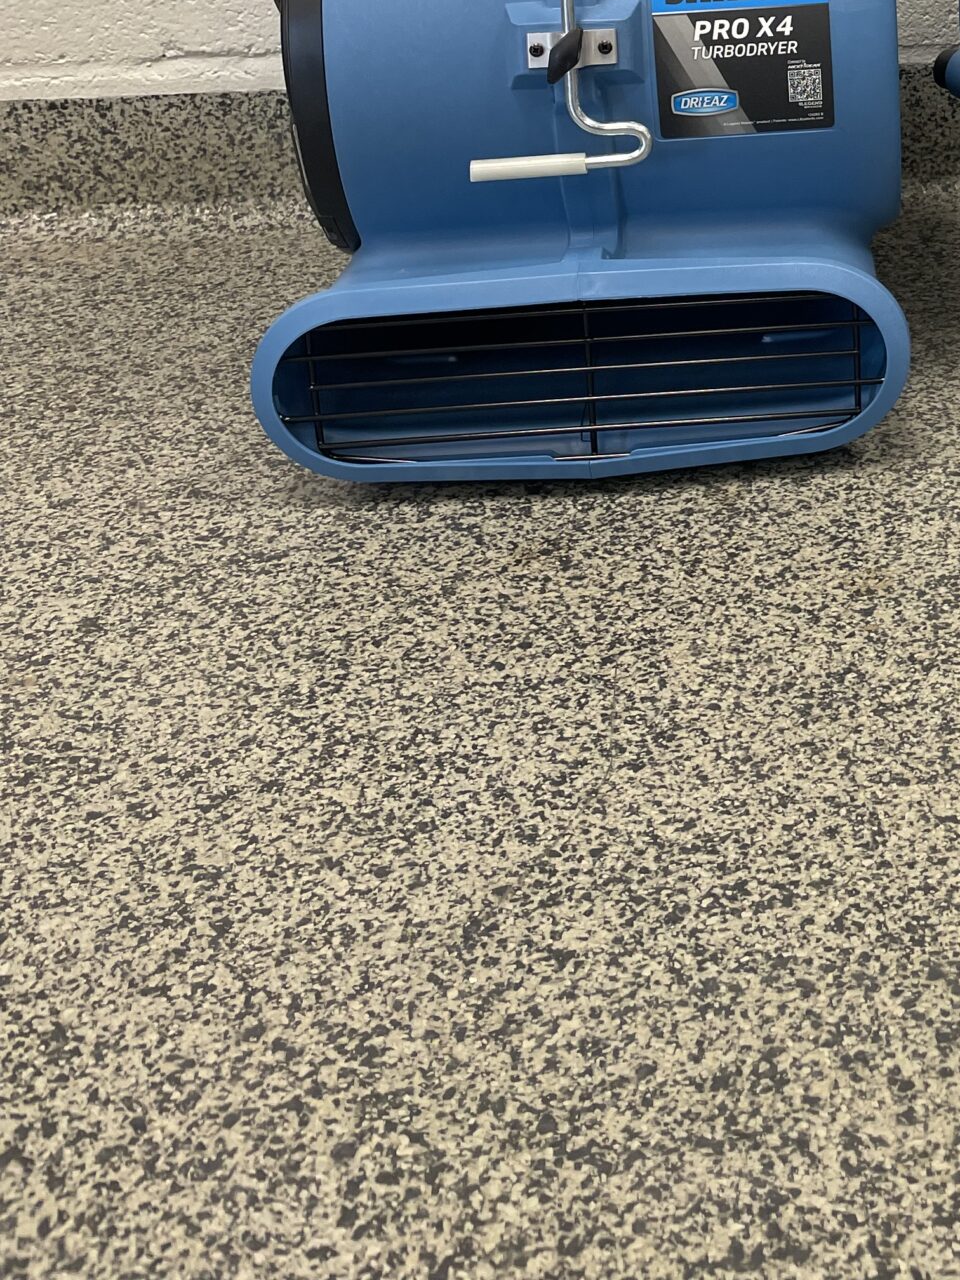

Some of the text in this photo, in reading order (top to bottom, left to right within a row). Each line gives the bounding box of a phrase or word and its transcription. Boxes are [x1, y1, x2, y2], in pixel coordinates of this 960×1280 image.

[693, 14, 794, 42] PRO X4
[691, 40, 798, 60] TURBODRYER
